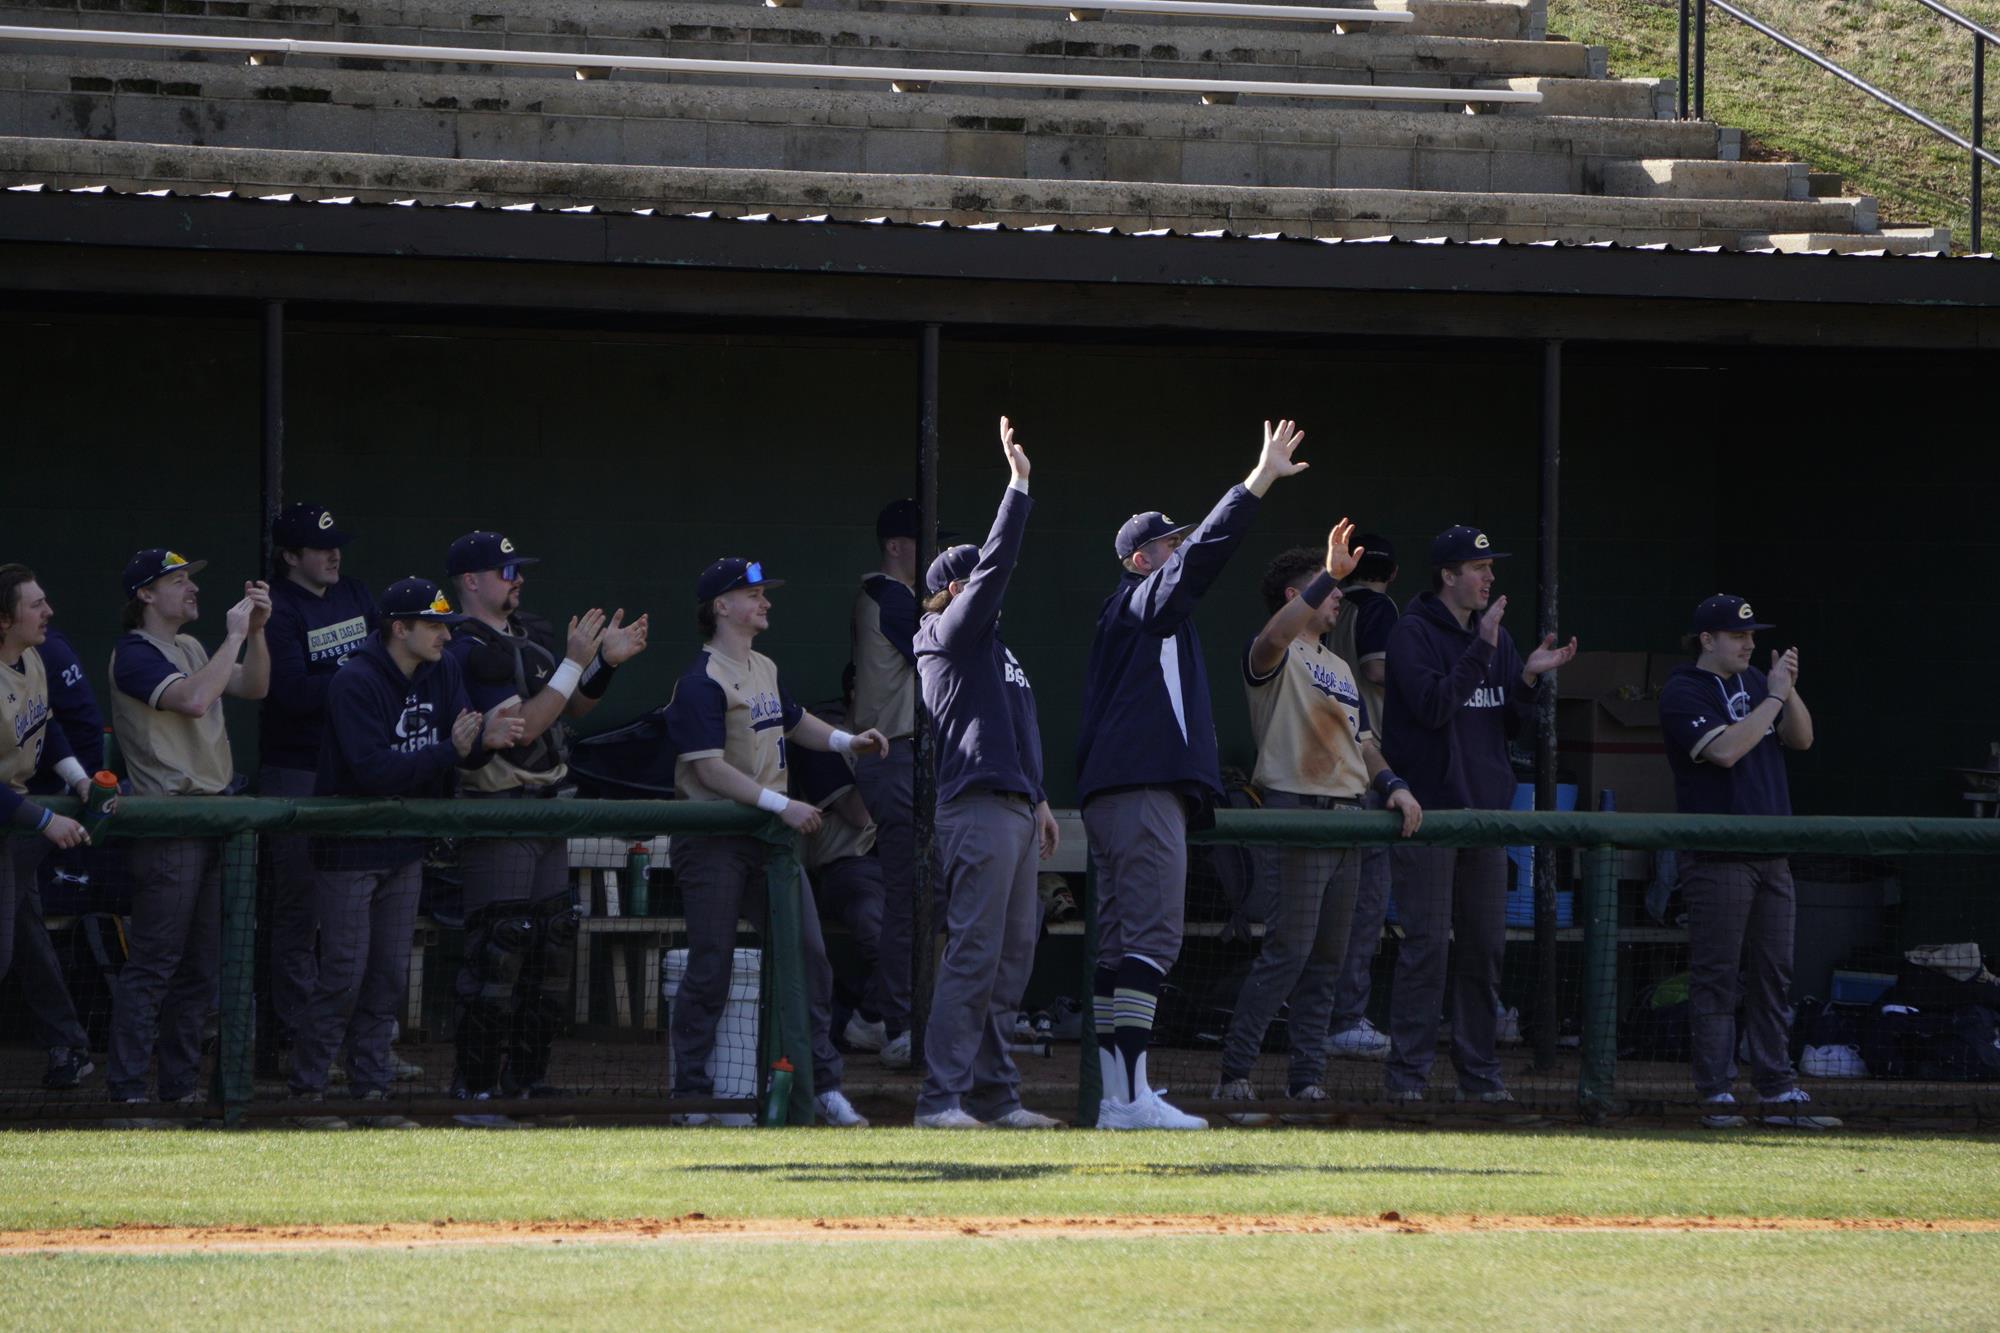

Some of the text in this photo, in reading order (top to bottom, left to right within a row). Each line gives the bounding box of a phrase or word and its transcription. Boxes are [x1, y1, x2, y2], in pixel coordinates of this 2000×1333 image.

[310, 622, 365, 648] GOLDEN EAGLES
[61, 663, 82, 688] 22
